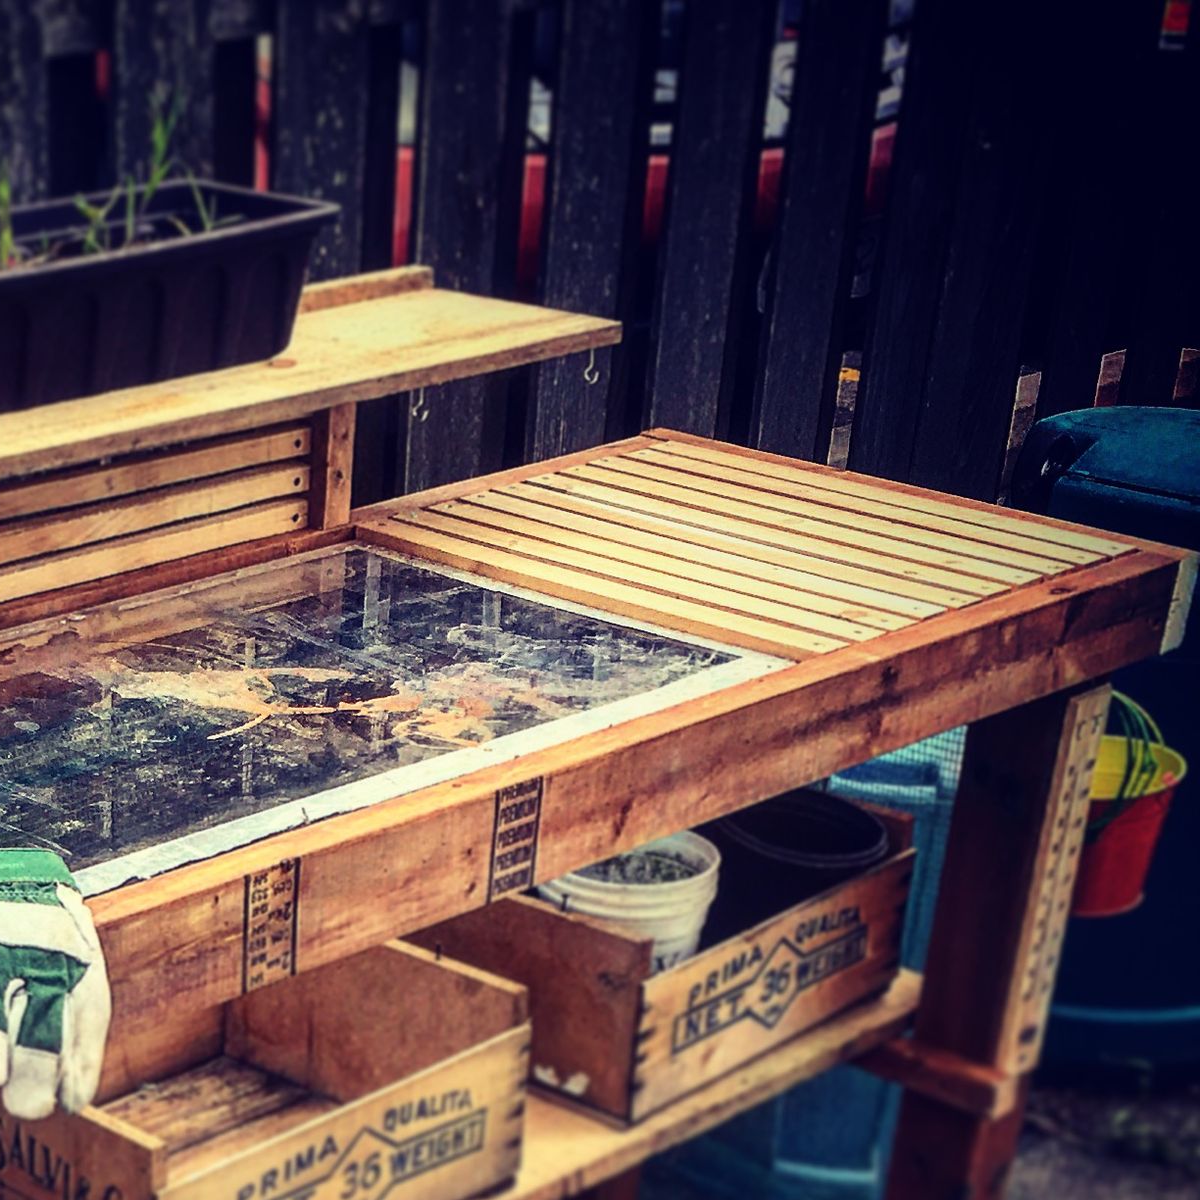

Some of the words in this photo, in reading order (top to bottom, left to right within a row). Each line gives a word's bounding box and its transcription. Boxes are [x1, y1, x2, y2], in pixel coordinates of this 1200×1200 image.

[688, 944, 764, 1009] PRIMA
[685, 991, 745, 1040] NET
[383, 1089, 473, 1132] QUALITA
[339, 1151, 382, 1200] 36
[389, 1120, 482, 1175] WEIGHT
